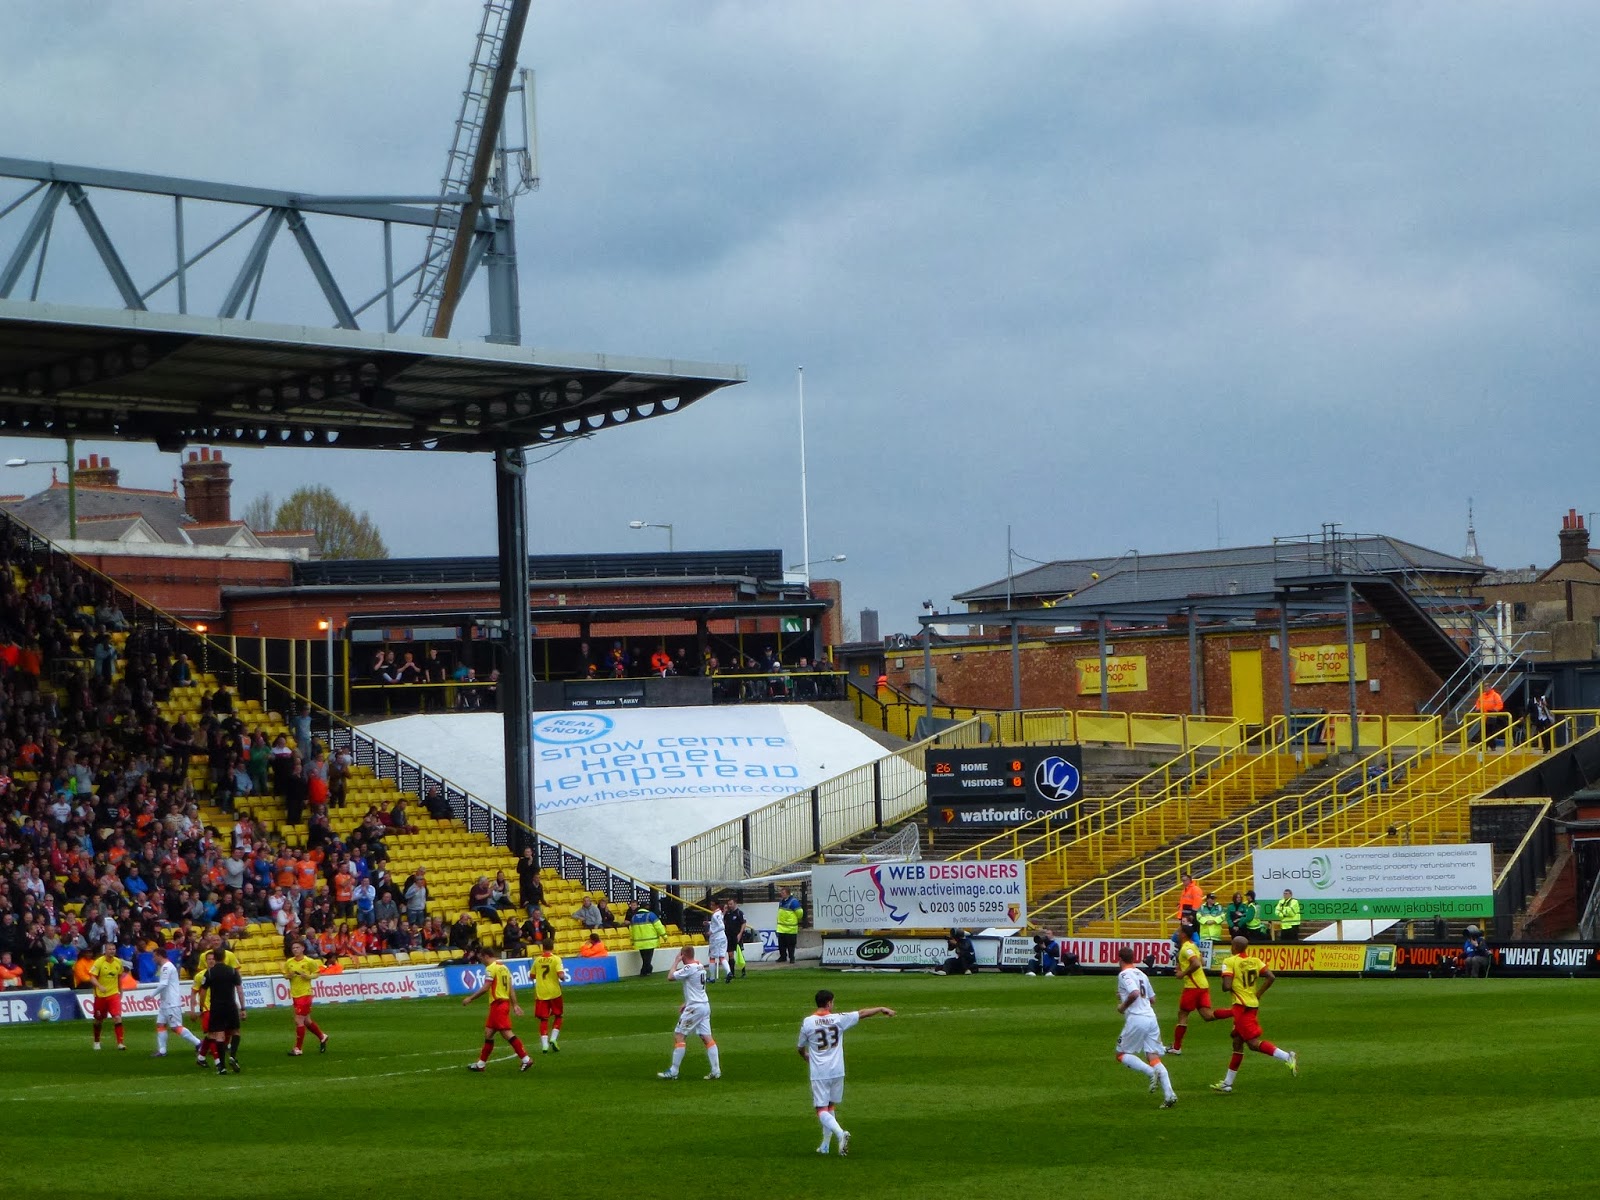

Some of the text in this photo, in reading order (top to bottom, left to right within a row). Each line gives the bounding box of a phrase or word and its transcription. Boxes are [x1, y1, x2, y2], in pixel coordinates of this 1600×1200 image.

[1300, 649, 1356, 661] the hornet
[1085, 661, 1137, 673] the ornets
[1316, 662, 1341, 672] shop
[554, 719, 594, 727] REAL
[541, 727, 595, 735] SNOW
[936, 763, 951, 773] 26
[960, 763, 988, 772] HOME
[962, 778, 1004, 788] VISITORS
[535, 783, 804, 811] www.thesnowcentre.com
[960, 807, 1068, 822] watfordfc.com
[889, 863, 1018, 880] WEB DESIGNERS
[1420, 861, 1476, 869] refurbishment
[1262, 867, 1321, 880] Jakobs
[827, 884, 875, 902] Active
[889, 881, 1020, 898] www.activeimage.co.uk
[816, 898, 865, 923] Image
[930, 901, 1004, 913] 0203 005 5295
[1309, 902, 1359, 914] 396224
[1373, 901, 1484, 915] www.jakobsltd.com
[827, 946, 854, 956] MAKE
[1099, 941, 1171, 965] BUDERS
[1320, 952, 1360, 961] WATFORD
[1541, 948, 1550, 966] A
[541, 964, 550, 980] 7
[501, 975, 508, 992] 4
[815, 1025, 839, 1051] 33
